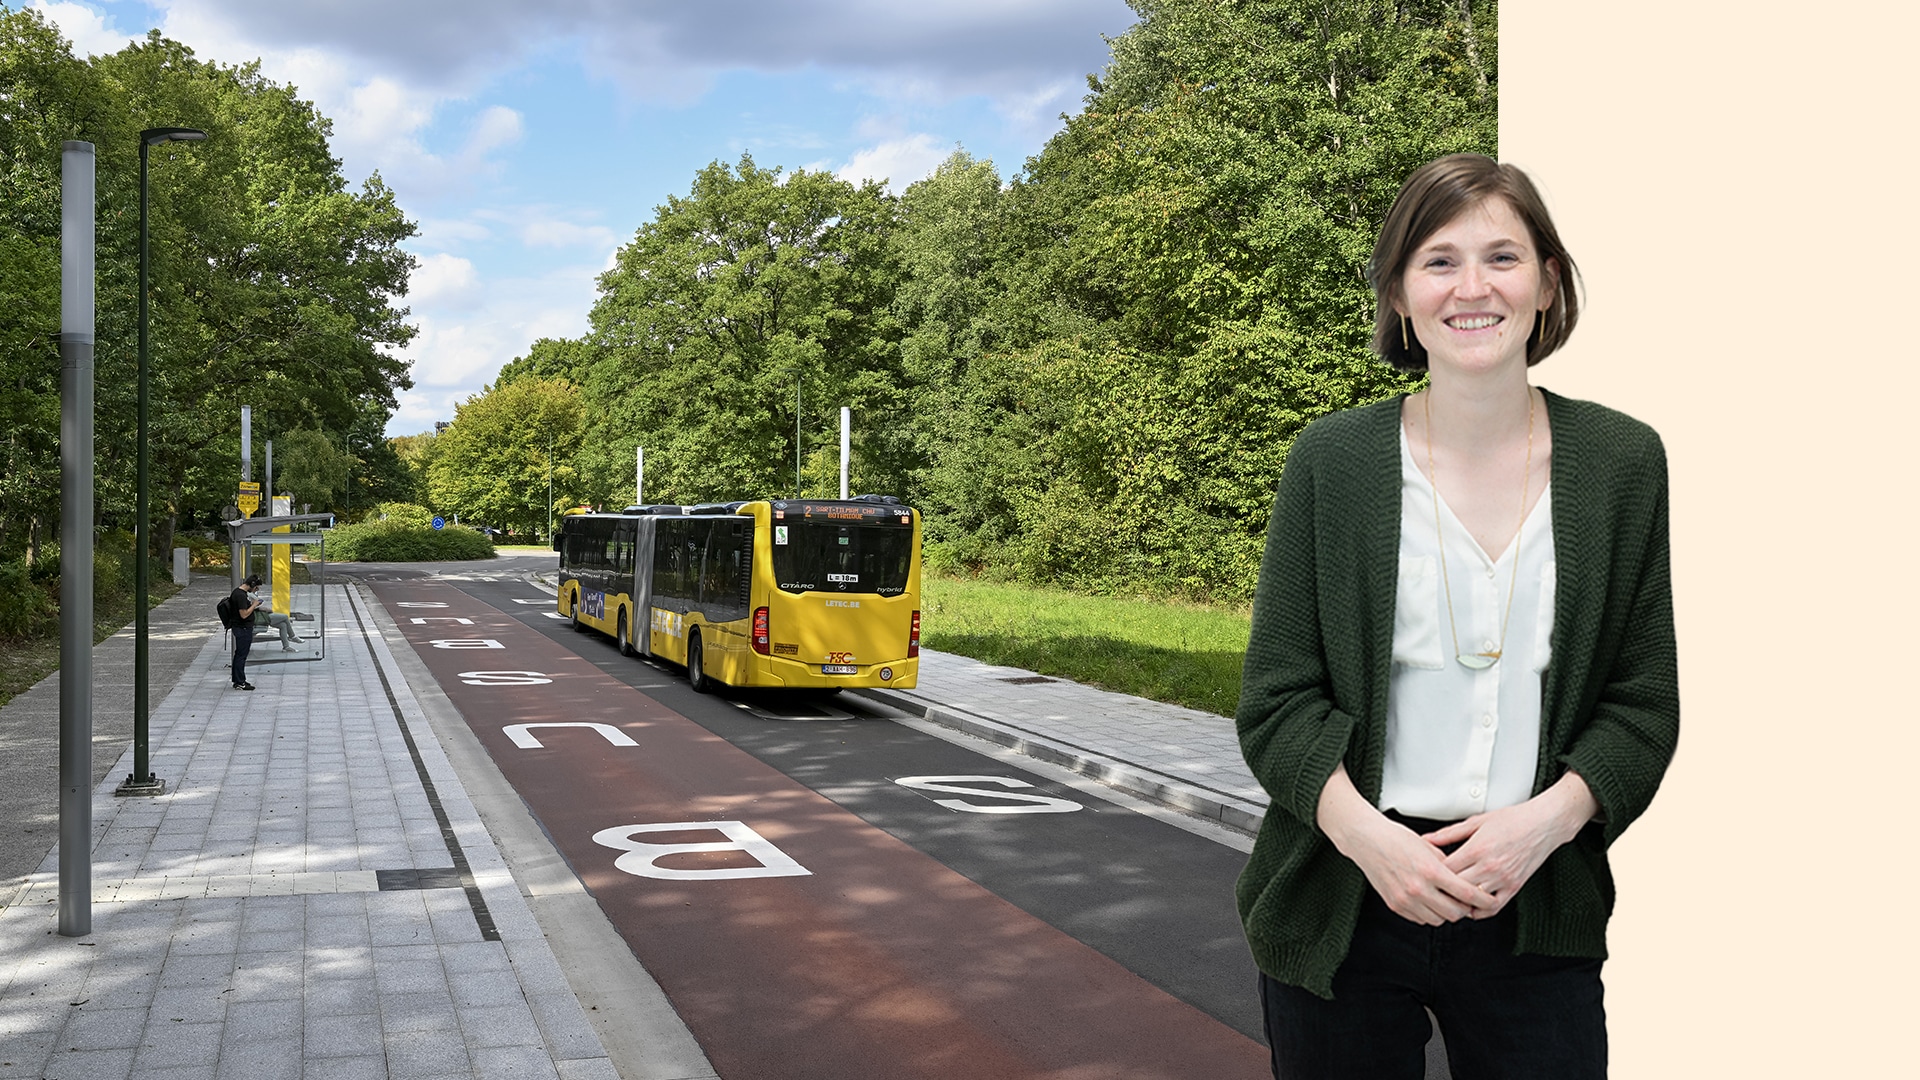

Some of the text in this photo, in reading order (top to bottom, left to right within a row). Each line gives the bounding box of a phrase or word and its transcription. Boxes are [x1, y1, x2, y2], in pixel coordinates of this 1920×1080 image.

[804, 506, 812, 518] 2
[876, 586, 903, 594] hybrid
[825, 600, 860, 608] LETEC.BE
